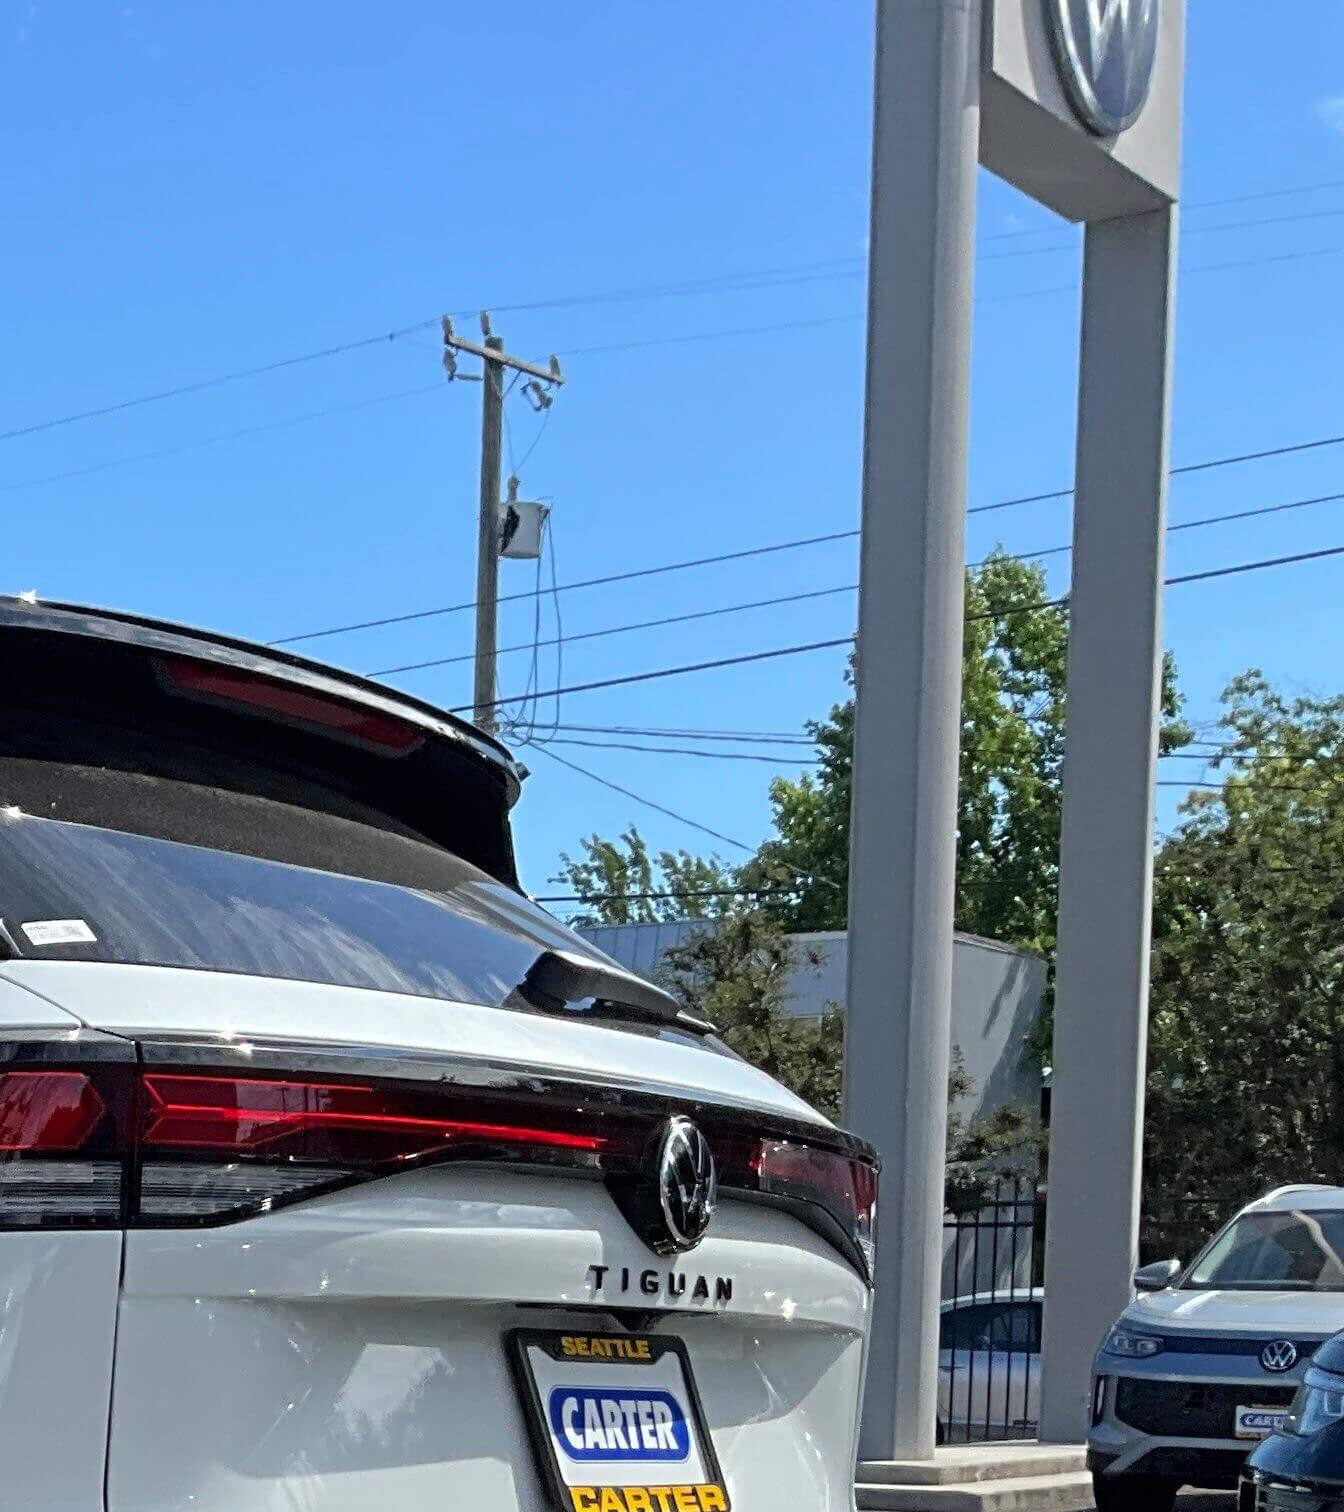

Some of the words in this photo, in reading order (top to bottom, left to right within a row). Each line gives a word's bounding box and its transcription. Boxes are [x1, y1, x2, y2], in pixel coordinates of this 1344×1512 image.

[588, 1264, 734, 1301] TIGUAN
[561, 1336, 652, 1360] SEATTLE
[562, 1396, 680, 1451] CARTER
